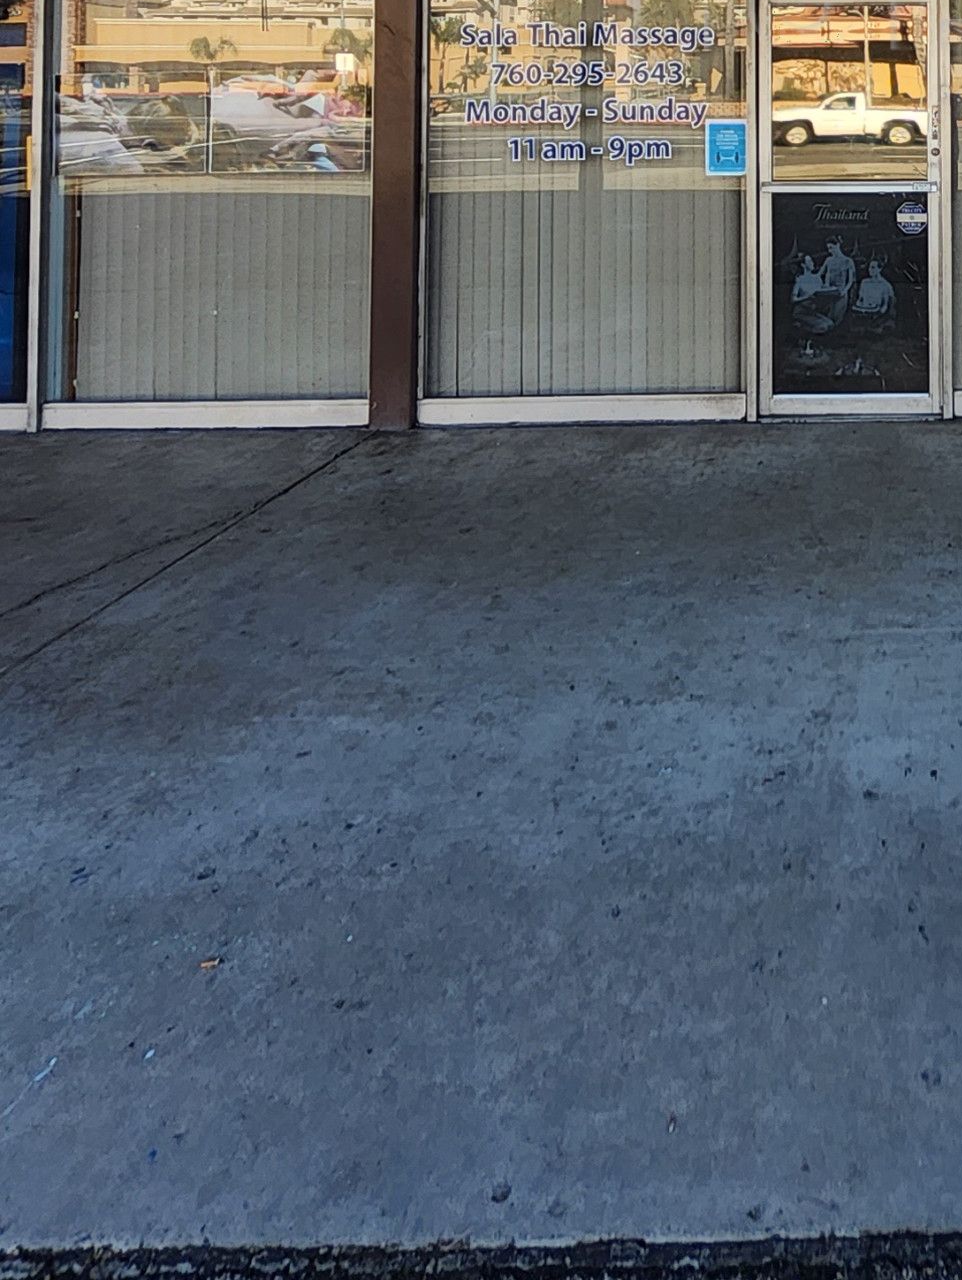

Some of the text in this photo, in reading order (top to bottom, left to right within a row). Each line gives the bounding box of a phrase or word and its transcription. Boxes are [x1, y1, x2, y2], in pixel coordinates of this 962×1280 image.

[460, 21, 714, 52] Sala Thai Massage
[491, 61, 684, 86] 760-295-2643
[465, 98, 581, 128] Monday
[602, 96, 708, 128] Sunday
[608, 135, 672, 165] 9pm
